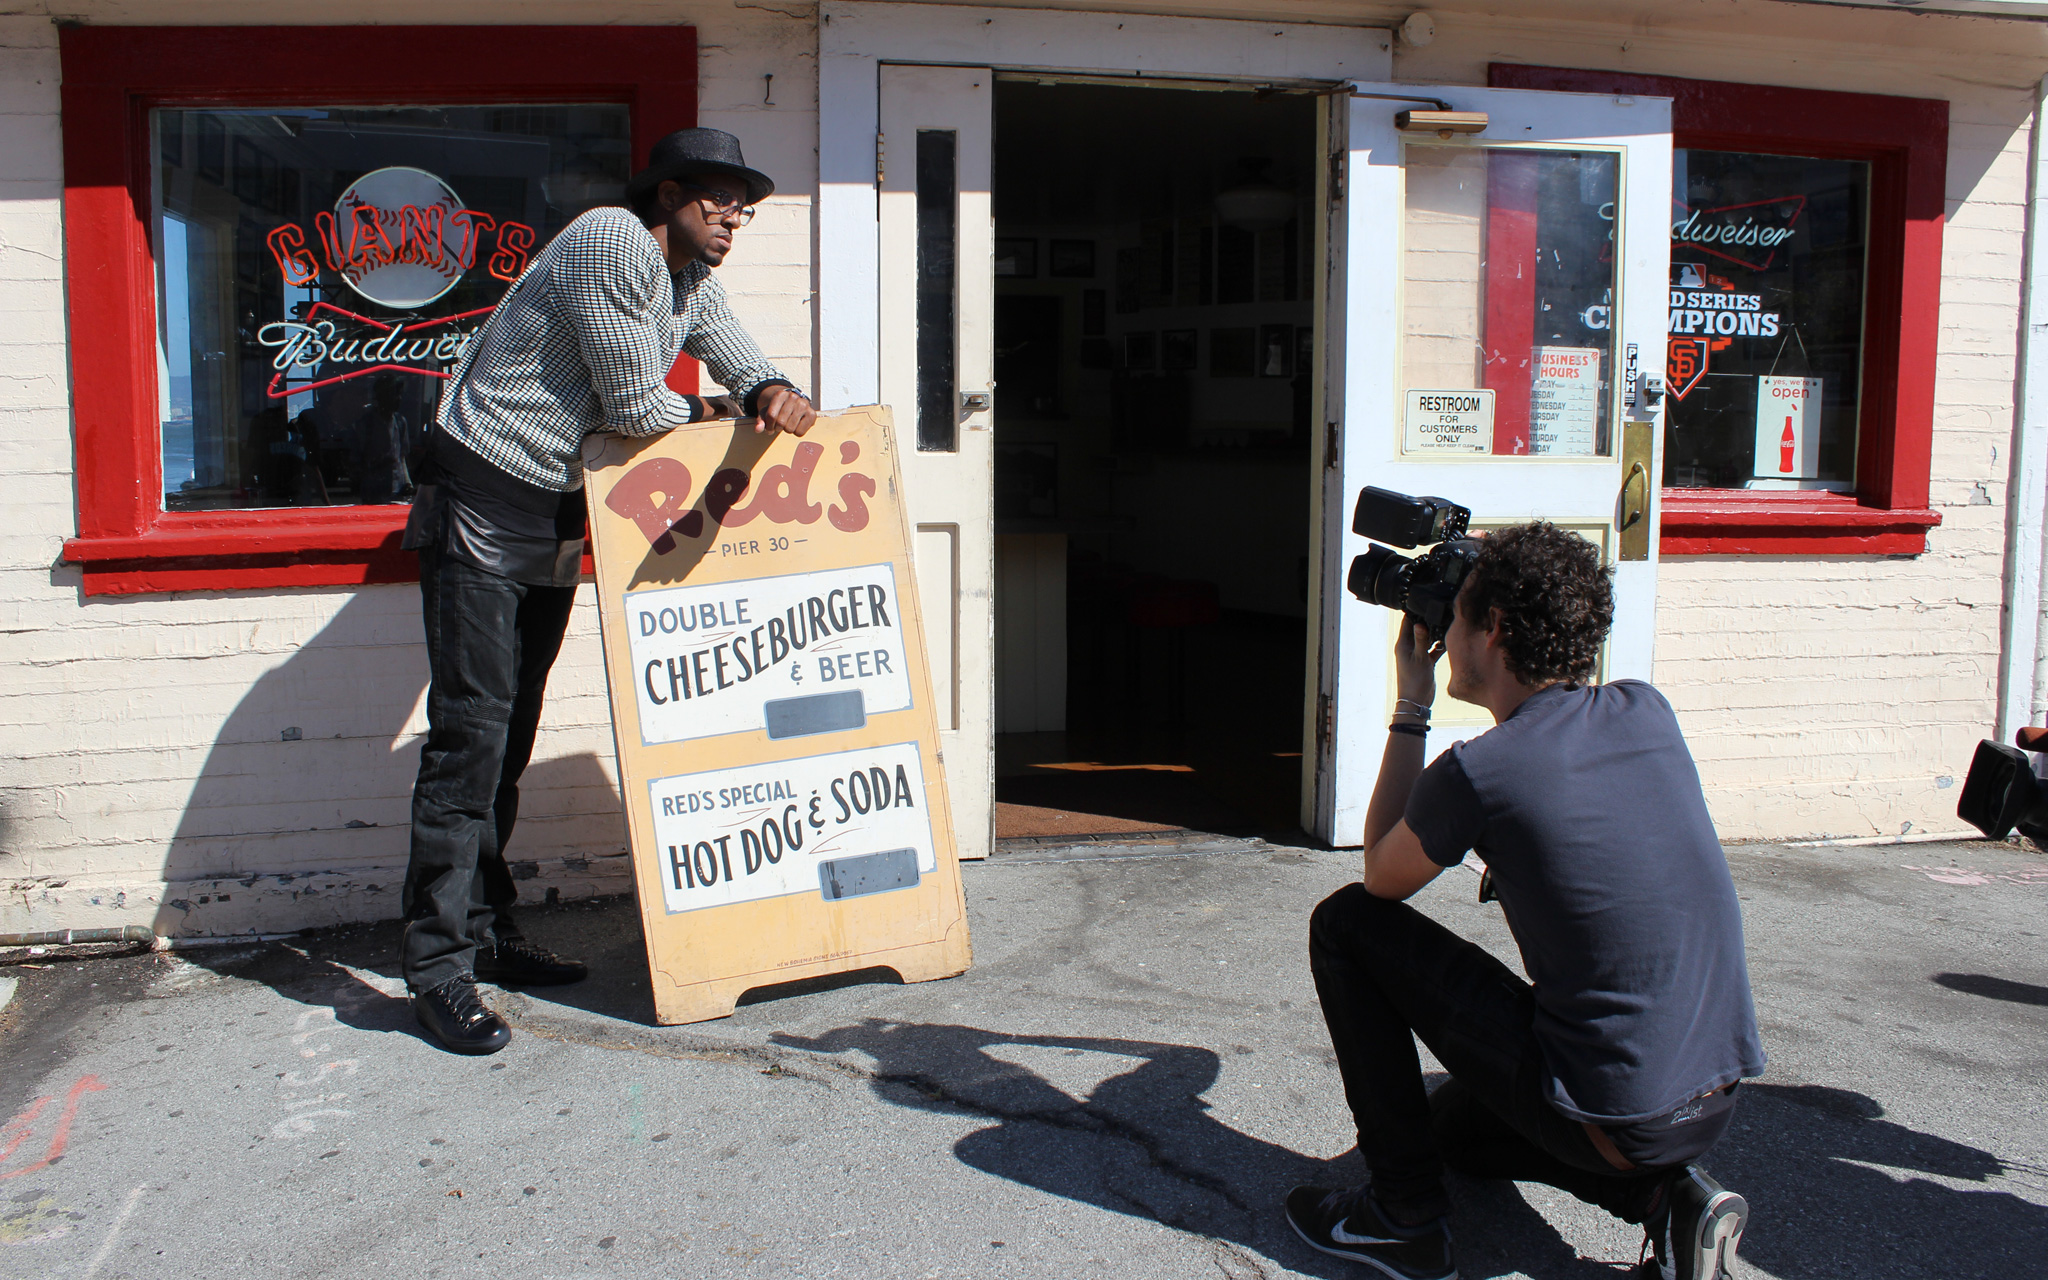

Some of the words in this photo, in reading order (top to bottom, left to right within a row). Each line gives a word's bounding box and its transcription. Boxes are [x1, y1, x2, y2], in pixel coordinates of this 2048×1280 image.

[266, 204, 535, 286] GIANTS
[1687, 291, 1761, 311] SERIES
[1584, 304, 1779, 337] CMPIONS
[258, 321, 479, 371] Budwei
[1540, 366, 1580, 379] HOURS
[1626, 347, 1637, 393] PUSH
[1419, 396, 1480, 411] RESTROOM
[1531, 401, 1567, 411] EDNESDAY
[1772, 387, 1810, 400] open
[1419, 424, 1478, 434] CUSTOMERS
[1439, 415, 1459, 423] FOR
[1435, 434, 1461, 443] ONLY
[604, 440, 876, 556] Red's
[721, 540, 760, 558] PIER
[769, 536, 789, 552] 30
[639, 598, 752, 637] DOUBLE
[644, 583, 892, 705] CHEESEBURGER
[818, 648, 894, 683] BEER
[662, 790, 715, 816] RED'S
[719, 779, 798, 809] SPECIAL
[668, 834, 733, 891] HOT
[740, 804, 804, 876] DOG
[830, 763, 914, 825] SODA
